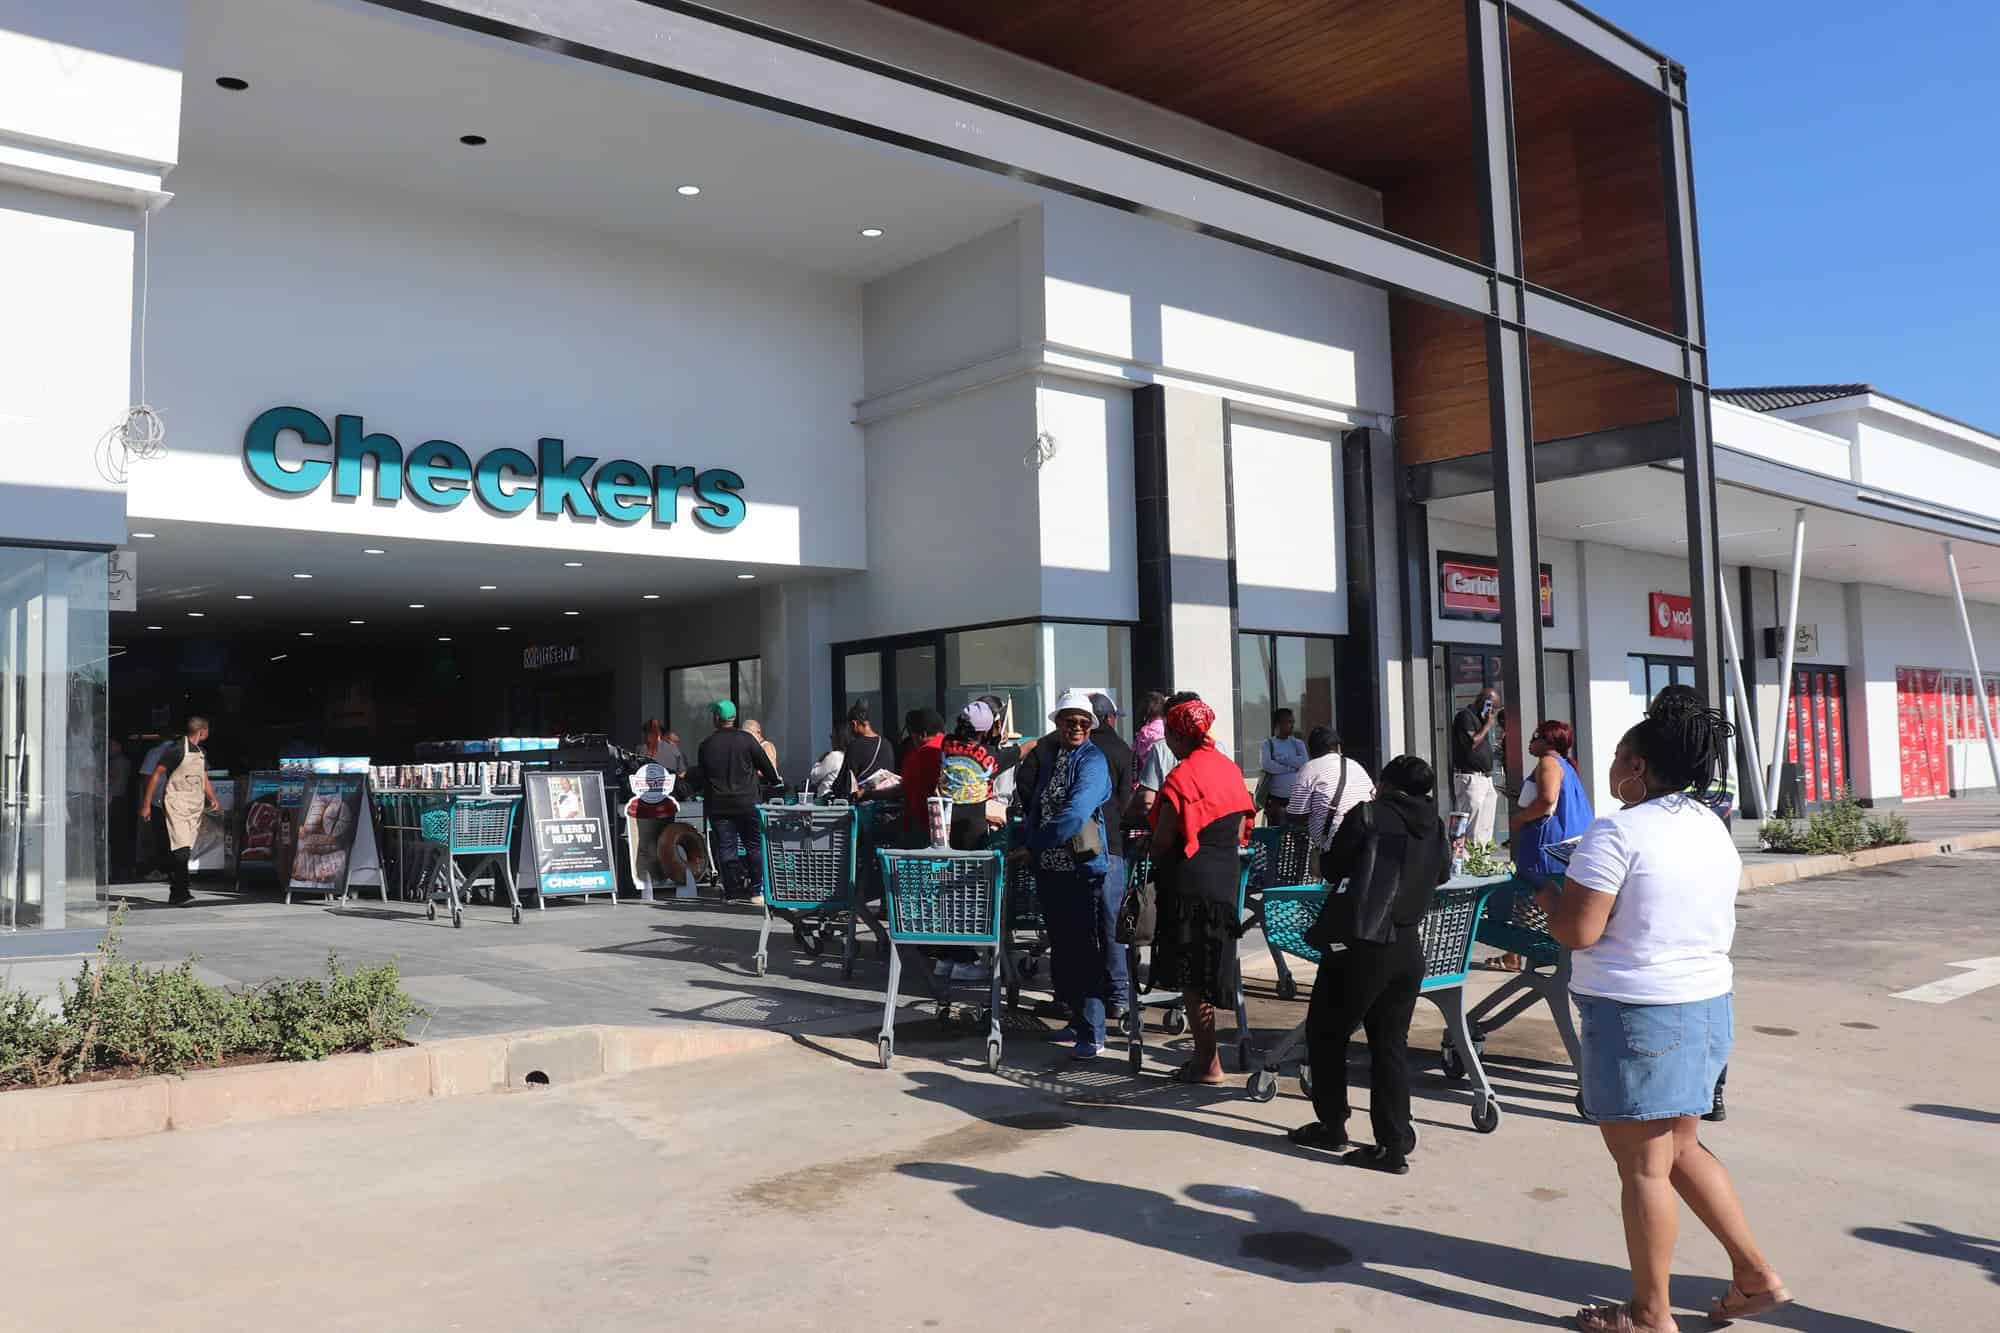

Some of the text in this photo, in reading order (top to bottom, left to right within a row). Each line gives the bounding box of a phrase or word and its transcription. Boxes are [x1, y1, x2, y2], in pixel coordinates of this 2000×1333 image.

[244, 406, 746, 528] Checkers
[561, 824, 583, 834] HERE
[584, 823, 596, 833] TO
[551, 833, 593, 844] HELP YOU
